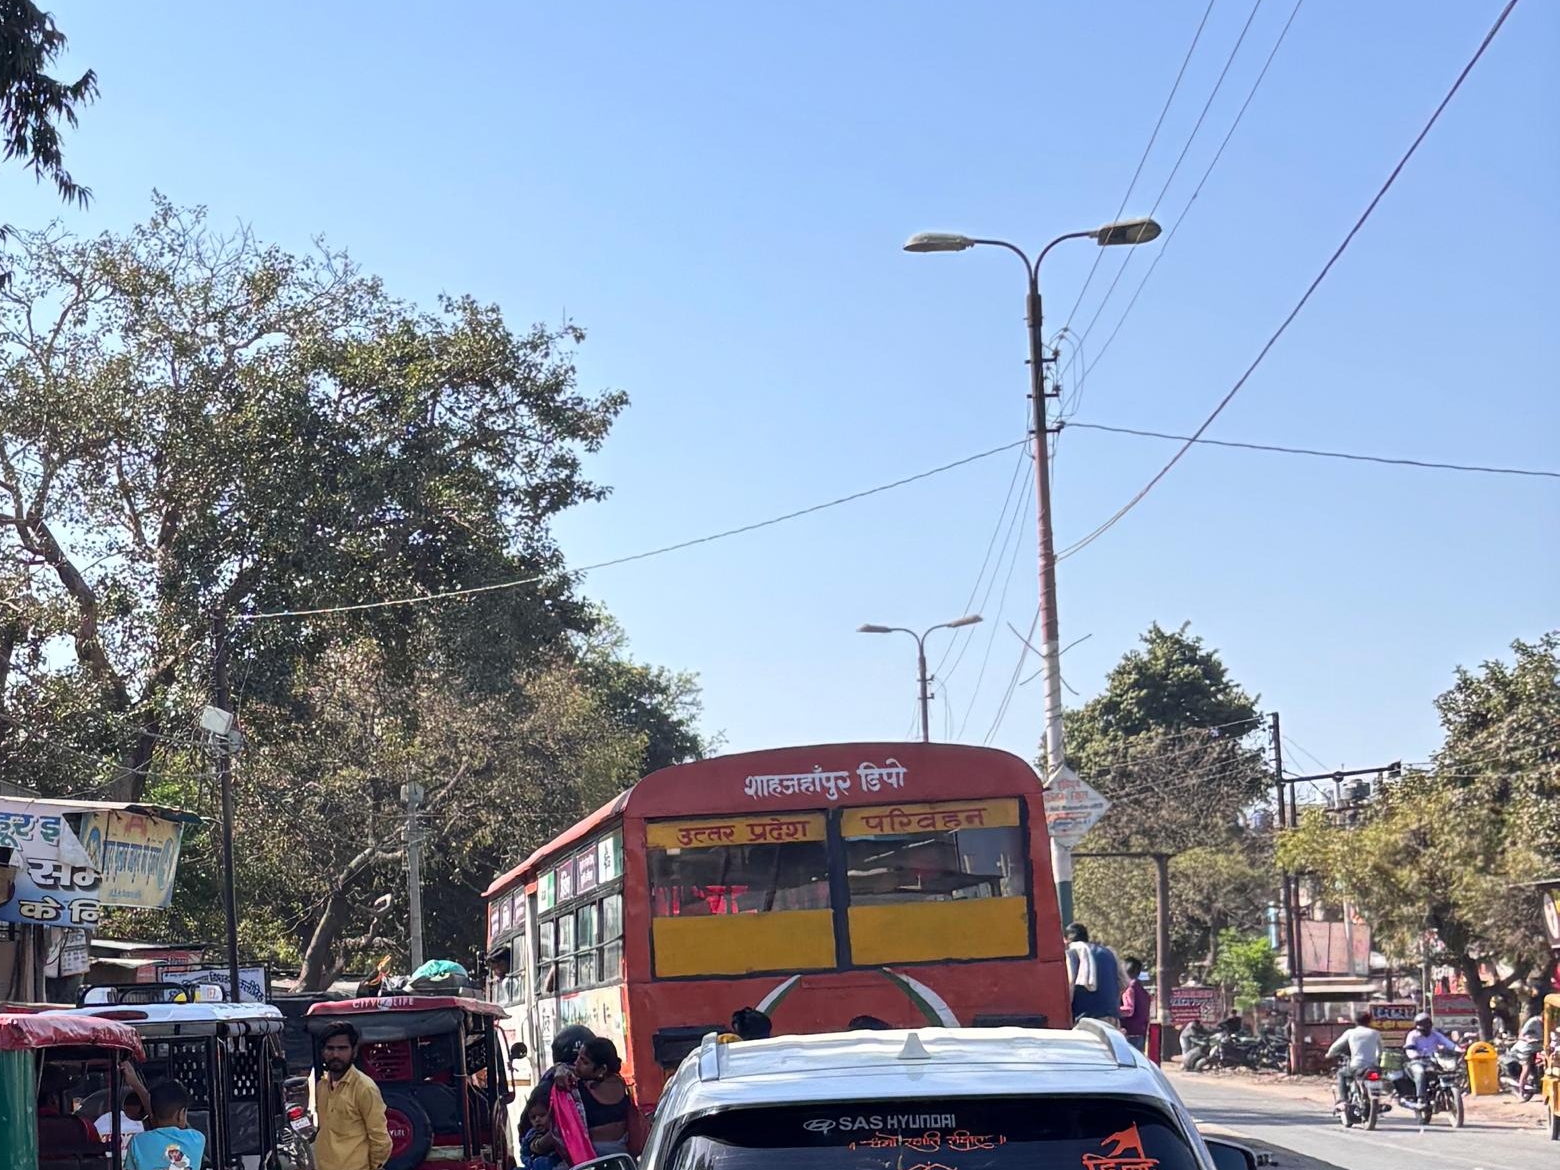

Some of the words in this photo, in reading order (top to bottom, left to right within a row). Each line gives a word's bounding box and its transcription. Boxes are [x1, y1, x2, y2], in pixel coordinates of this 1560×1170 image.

[856, 758, 908, 792] डिपो
[676, 824, 736, 848] उत्तर
[745, 817, 810, 842] प्रदेश
[861, 806, 988, 834] परिवहन
[18, 894, 62, 921] के
[352, 998, 378, 1009] CITY
[839, 1115, 884, 1131] SAS
[887, 1113, 956, 1130] HYUNDAI
